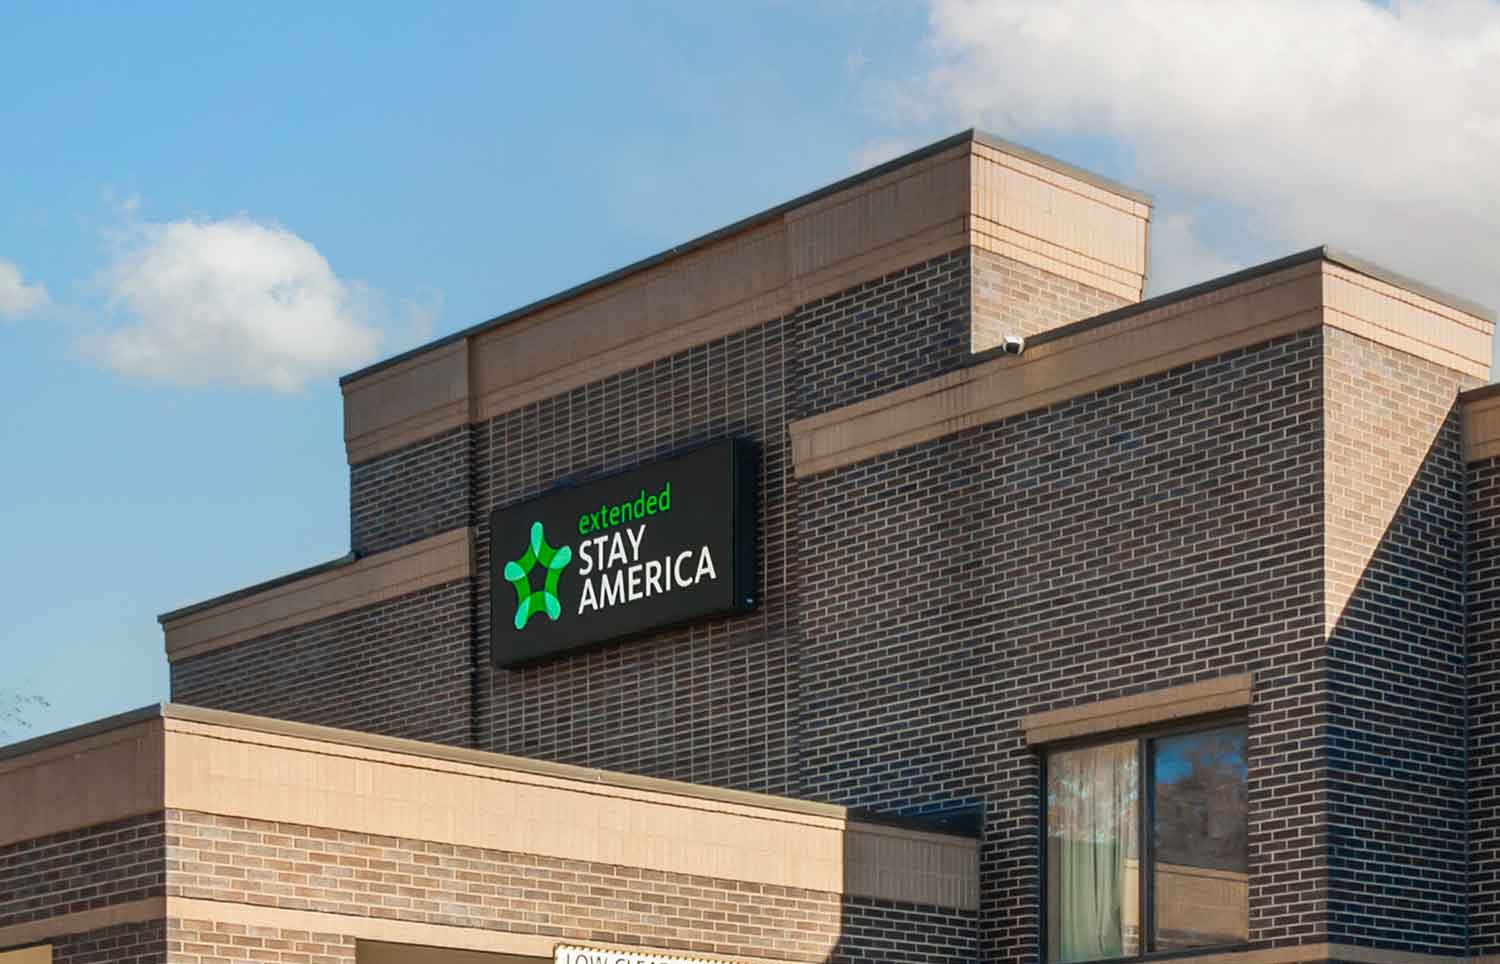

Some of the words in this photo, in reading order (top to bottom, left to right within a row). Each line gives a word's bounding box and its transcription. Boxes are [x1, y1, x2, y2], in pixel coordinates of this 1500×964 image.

[577, 481, 672, 535] extended
[578, 524, 647, 576] STAY
[577, 545, 718, 615] AMERICA
